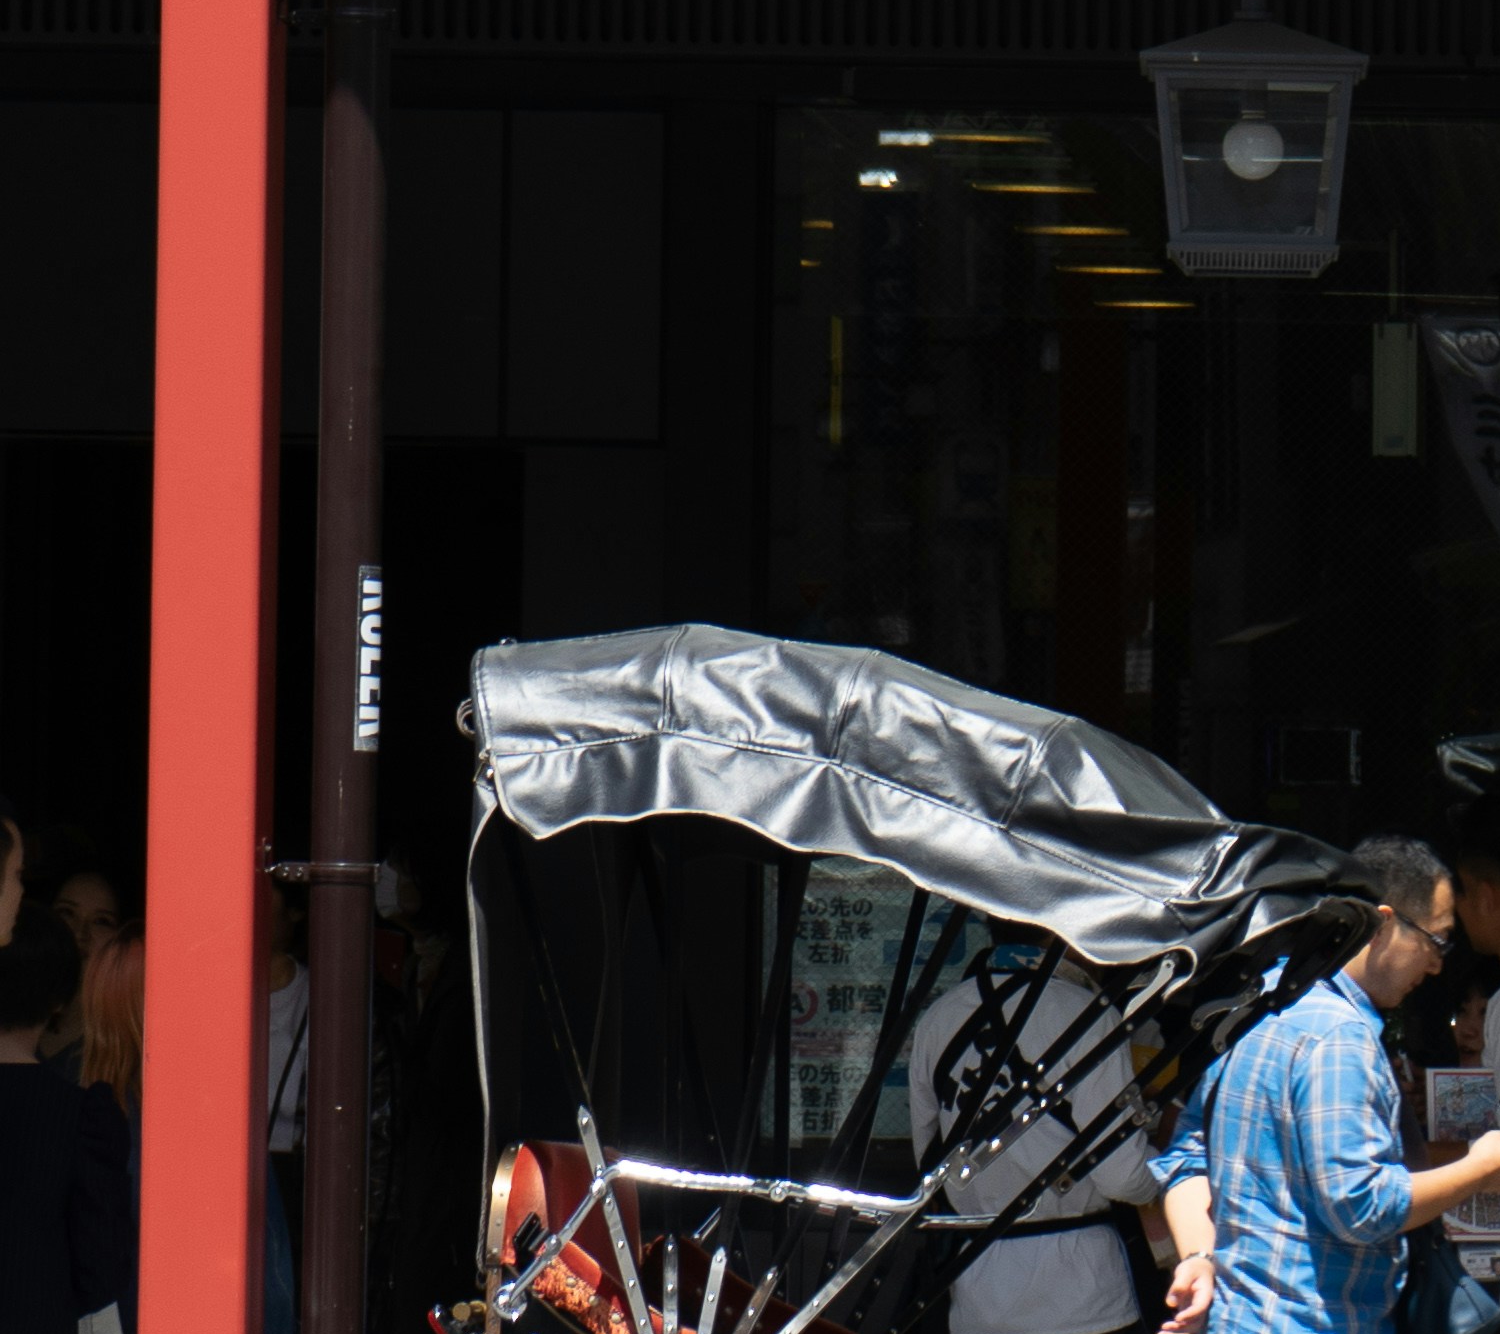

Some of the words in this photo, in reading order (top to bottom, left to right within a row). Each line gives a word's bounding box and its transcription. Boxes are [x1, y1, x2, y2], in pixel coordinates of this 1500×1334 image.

[799, 898, 873, 916] の先の
[808, 942, 852, 964] 左折
